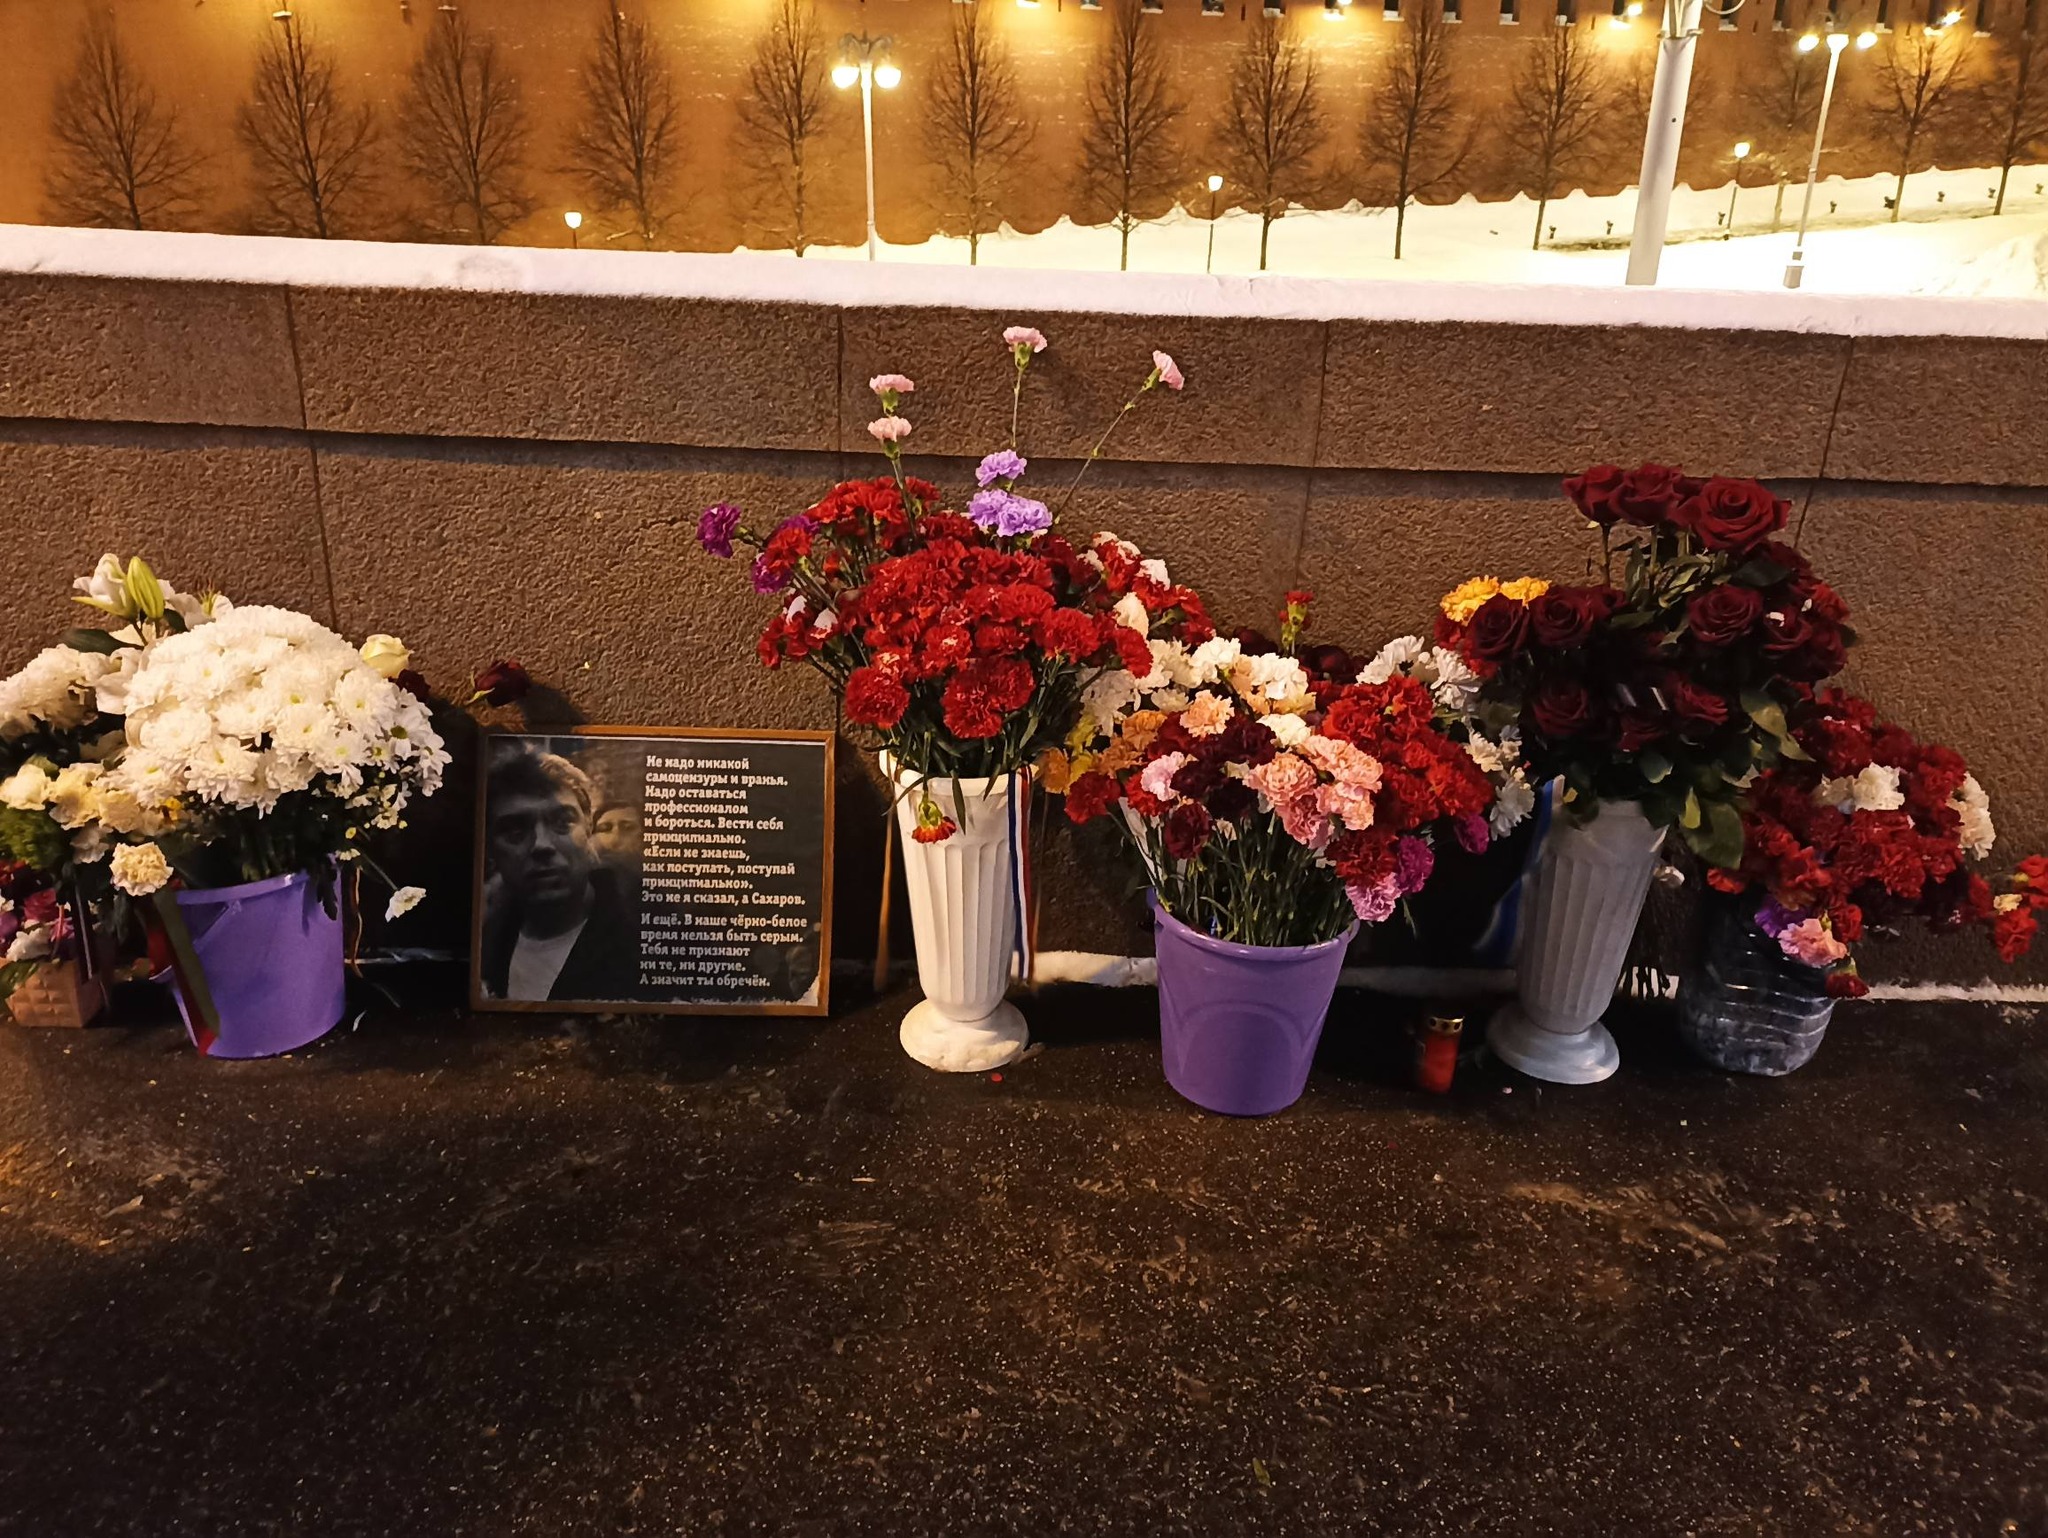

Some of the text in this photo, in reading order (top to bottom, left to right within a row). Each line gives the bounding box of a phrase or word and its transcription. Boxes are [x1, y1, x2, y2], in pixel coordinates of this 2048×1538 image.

[646, 756, 749, 770] Не надо никакой
[646, 772, 788, 787] самоцензуры и вранья.
[645, 786, 746, 799] Надо оставаться
[645, 800, 748, 815] профессионалом
[644, 815, 783, 830] и бороться. Вести себя
[643, 832, 746, 845] принципиально.
[644, 846, 750, 861] «Если не знаешь,
[642, 862, 795, 877] как поступать, поступай
[642, 878, 753, 890] принципиально».
[642, 891, 805, 907] Это не я сказал, а Сахаров.
[641, 913, 807, 929] И ещё. В наше чёрно-белое
[641, 929, 803, 945] время нельзя быть серым.
[641, 943, 750, 958] Тебя не признают
[640, 960, 746, 973] ни те, ни другие.
[640, 973, 770, 988] А значит ты обречён.
